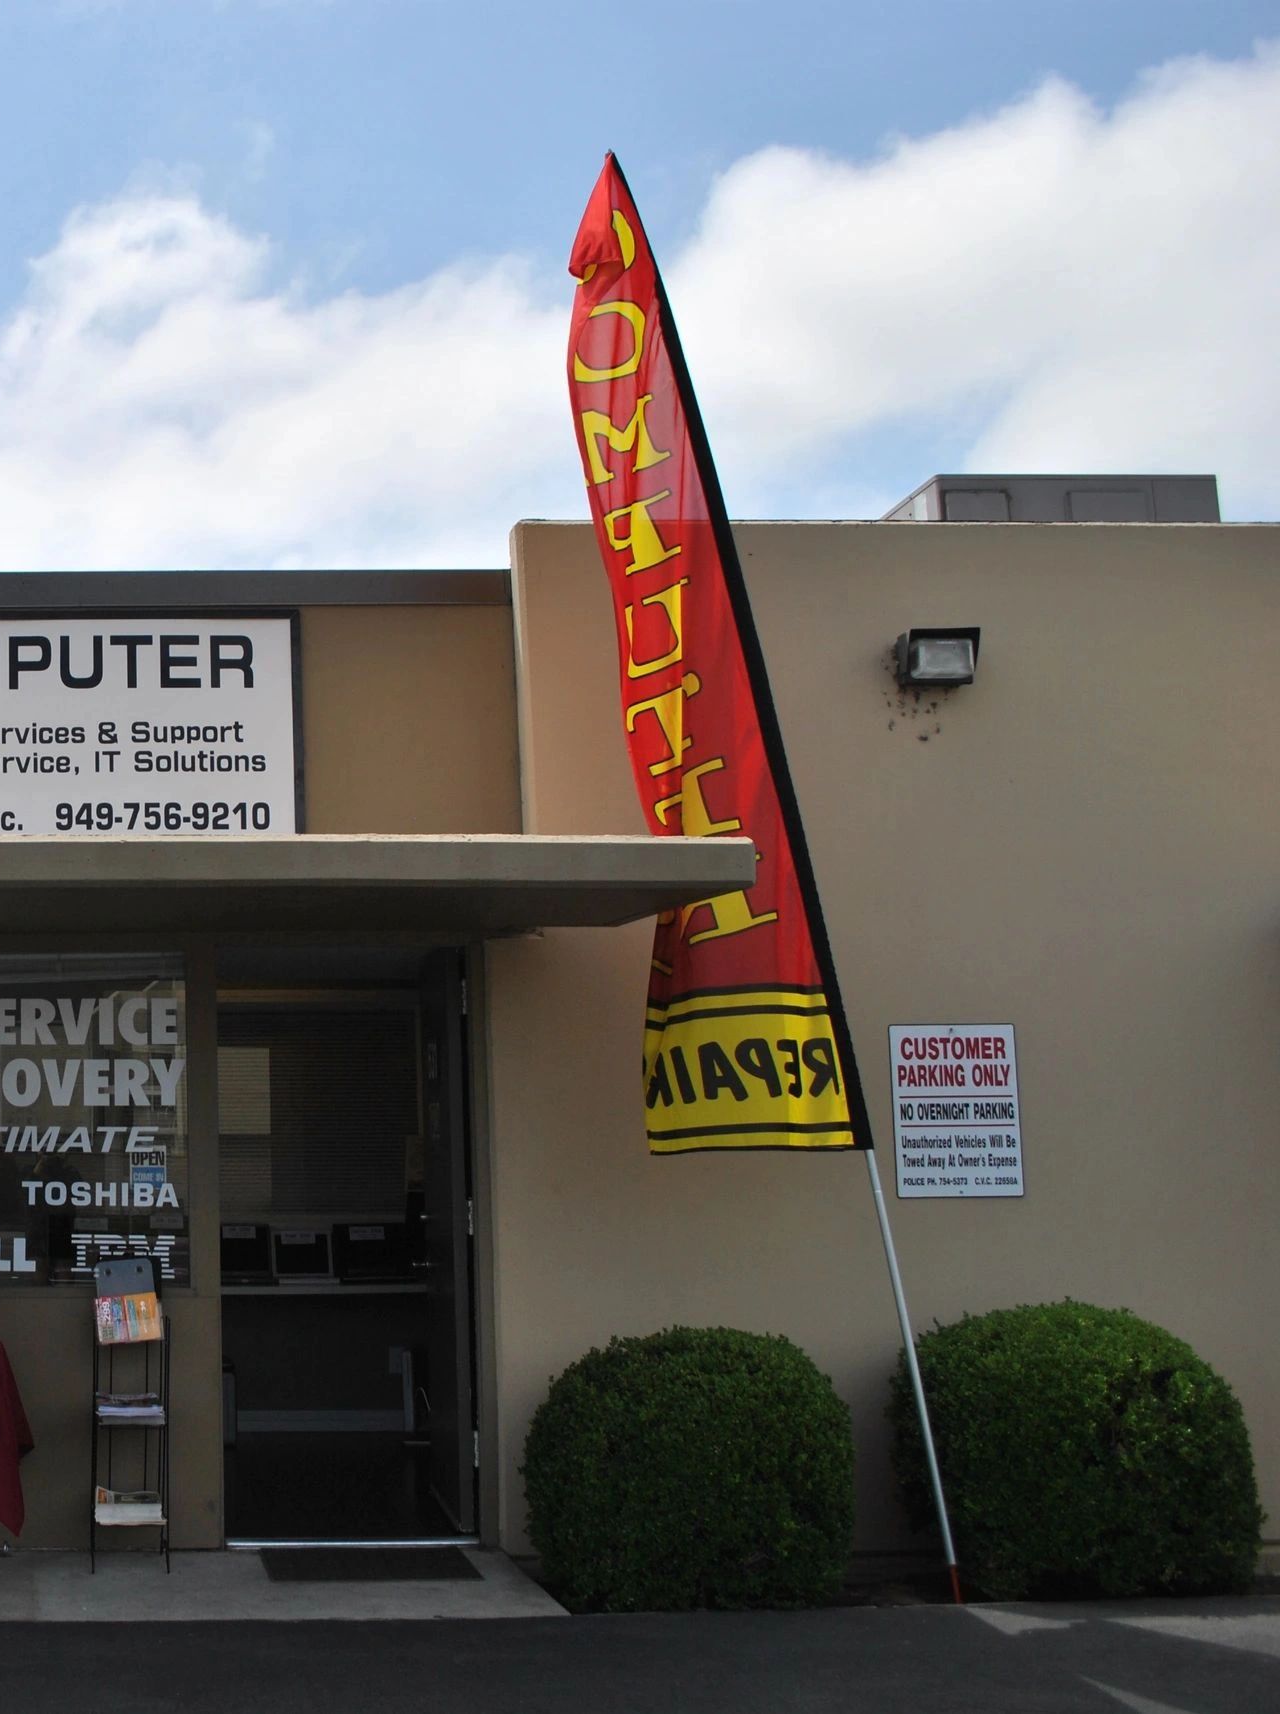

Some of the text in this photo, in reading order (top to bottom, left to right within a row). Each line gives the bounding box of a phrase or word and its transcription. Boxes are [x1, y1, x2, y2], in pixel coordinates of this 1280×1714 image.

[97, 721, 119, 745] &
[131, 721, 244, 745] Support
[94, 750, 121, 773] IT
[134, 750, 267, 773] Solutions
[55, 801, 271, 831] 949-756-9210
[900, 1037, 1006, 1060] CUSTOMER
[898, 1064, 1011, 1087] PARKING ONLY
[900, 1102, 1015, 1120] NO OVERNIGHT PARKING
[901, 1134, 1017, 1149] Unauthorized Vehicles Will Be
[131, 1151, 165, 1166] OPEN
[902, 1153, 1018, 1170] Towed Away At Owner's Expense
[903, 1177, 925, 1186] POLICE
[21, 1181, 180, 1208] TOSHIBA
